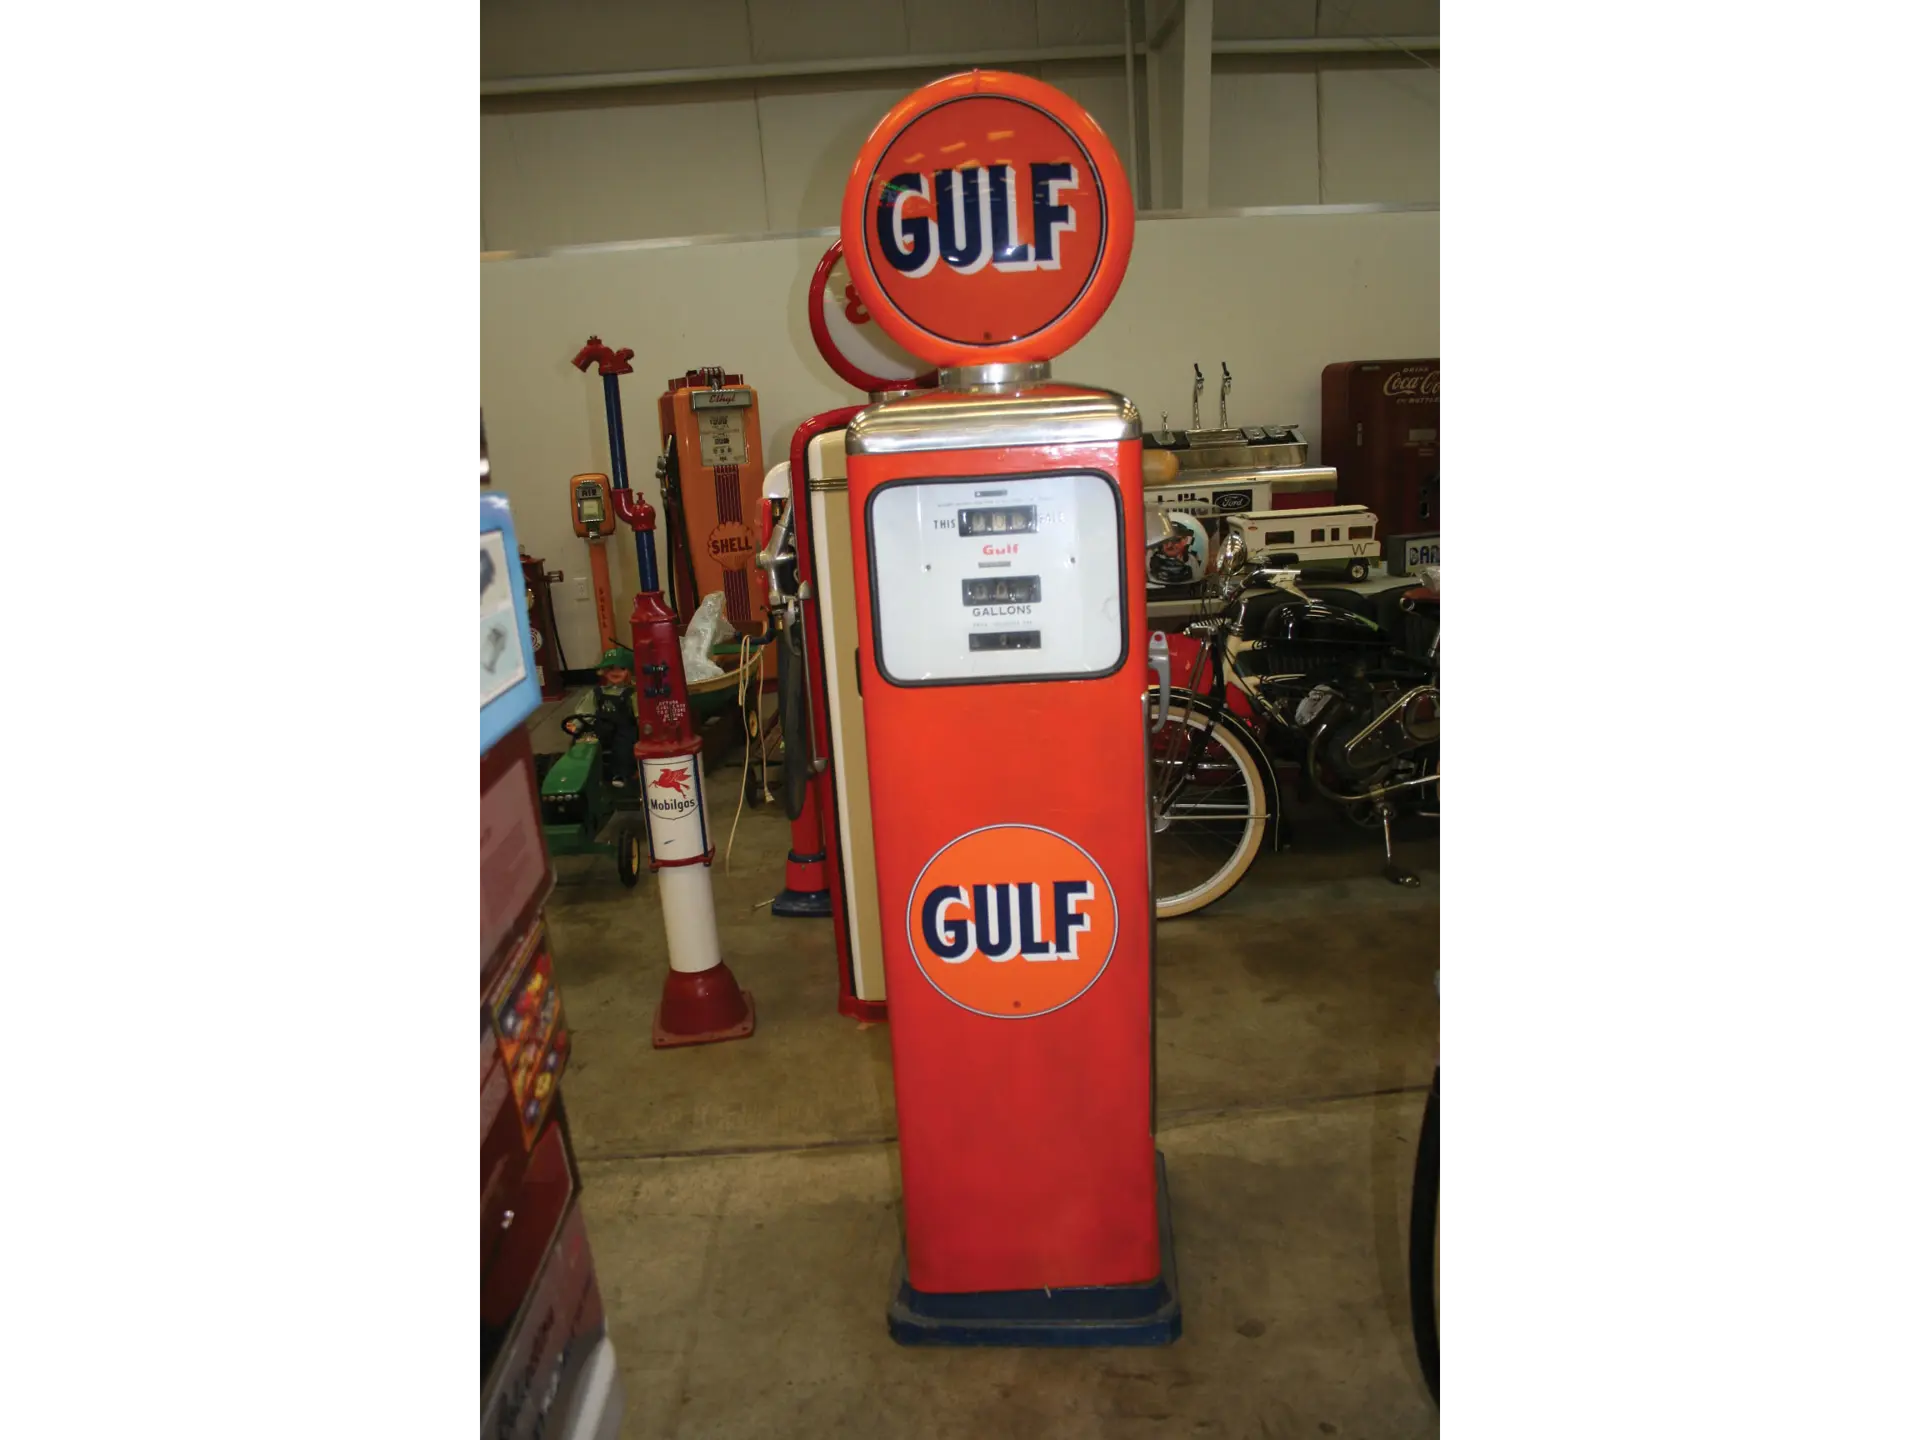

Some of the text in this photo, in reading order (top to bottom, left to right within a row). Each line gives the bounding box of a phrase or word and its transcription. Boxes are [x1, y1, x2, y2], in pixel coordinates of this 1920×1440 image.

[876, 162, 1080, 279] GULF
[1222, 495, 1243, 508] Ford
[933, 519, 957, 530] THIS
[711, 536, 753, 554] SHELL
[982, 543, 1019, 556] Gulf
[972, 605, 1032, 617] GALLONS
[650, 798, 696, 813] Mobilgas
[921, 880, 1095, 964] GULF
